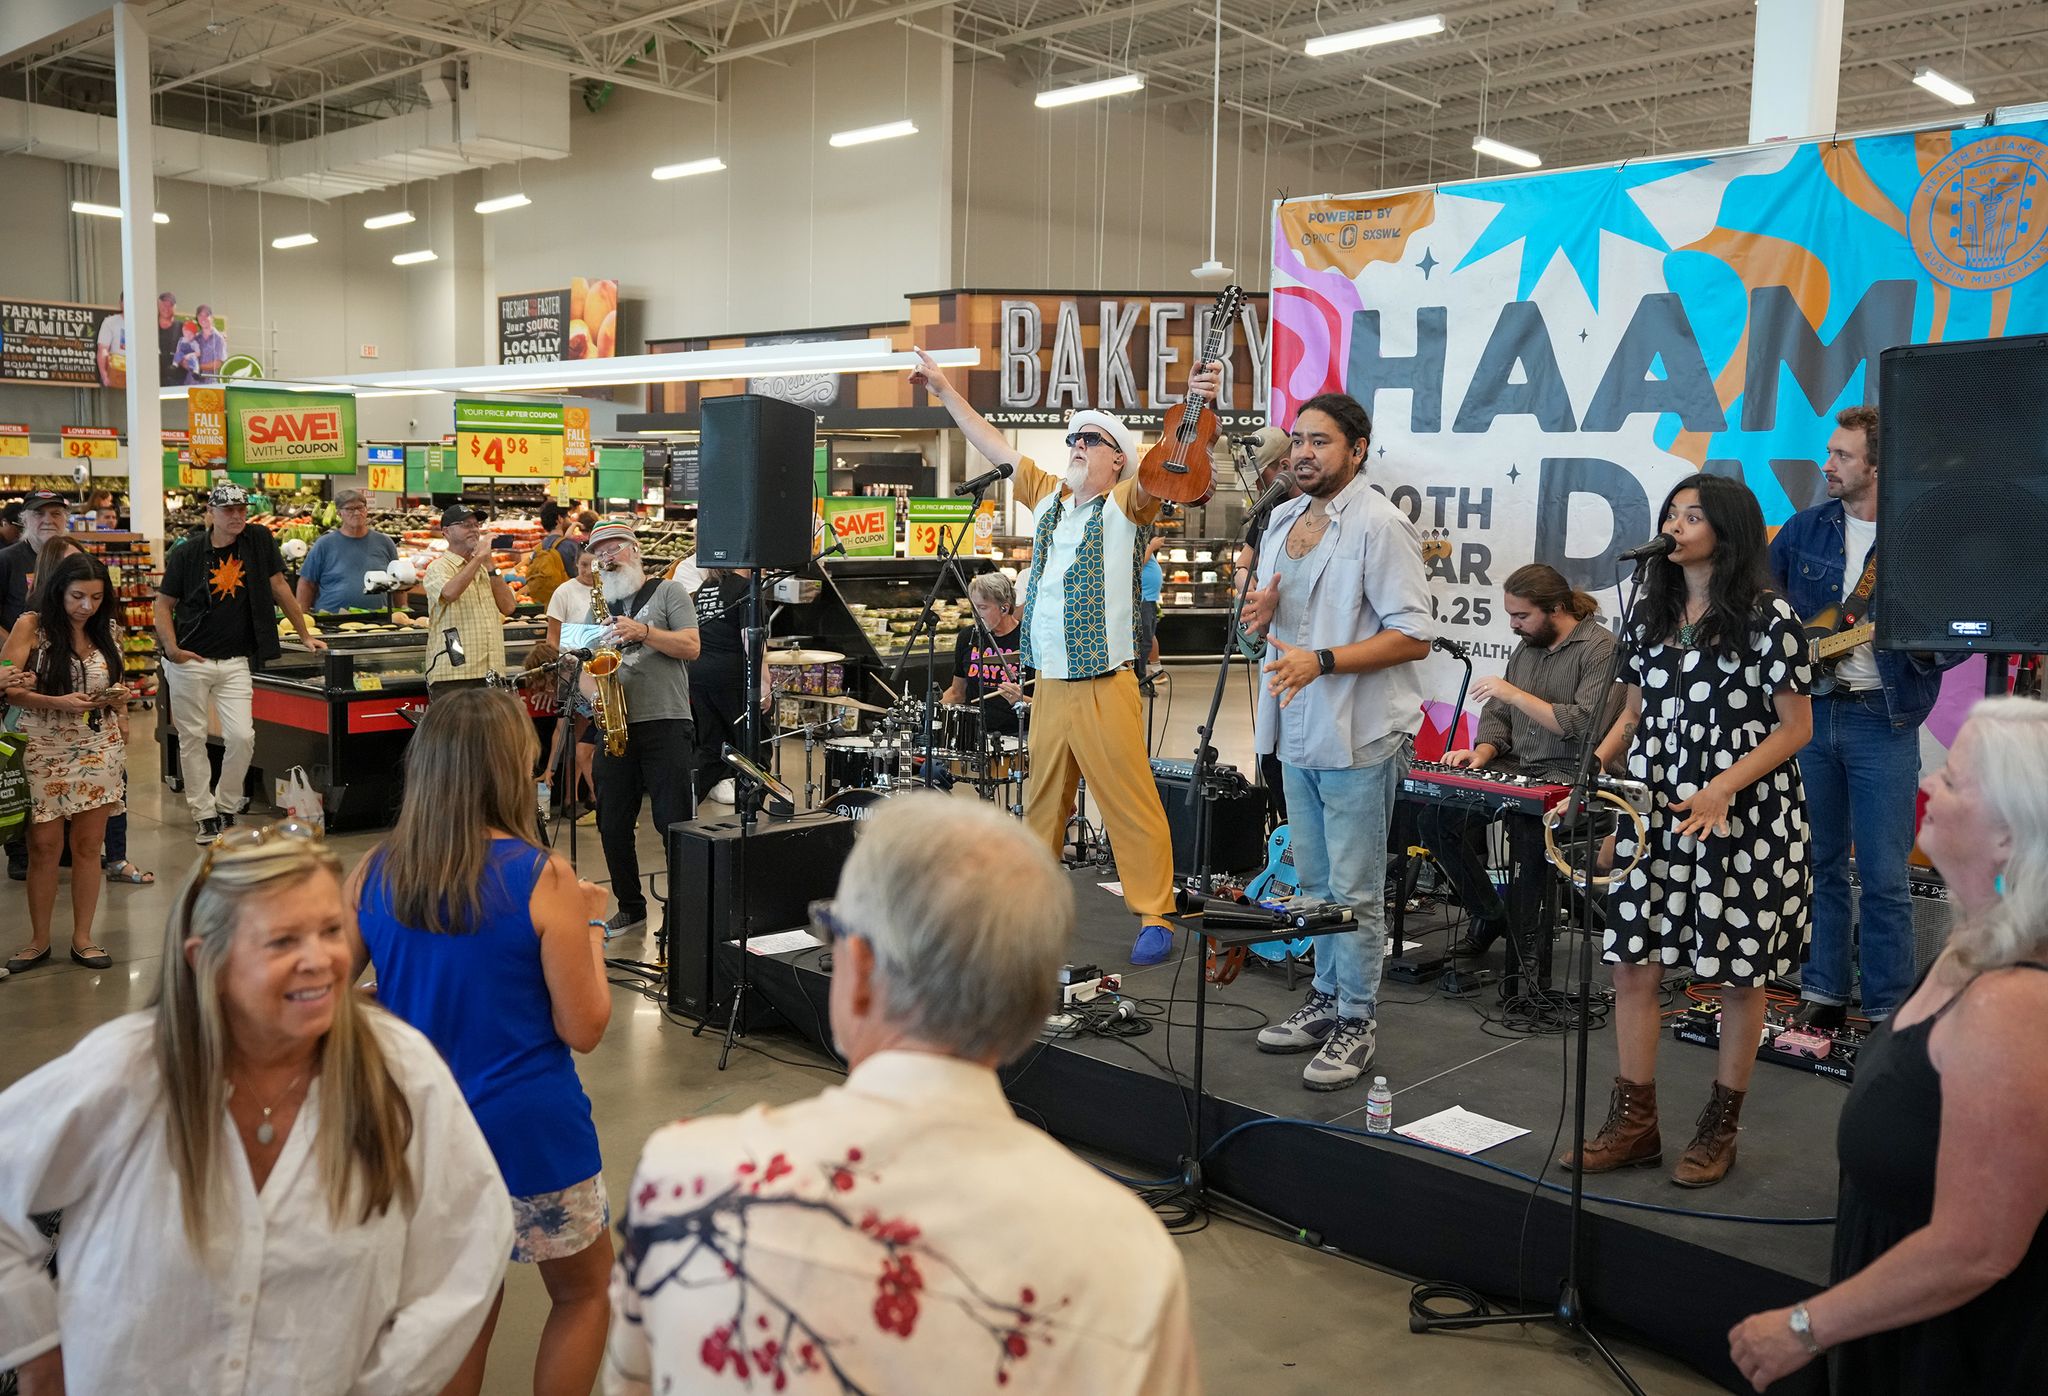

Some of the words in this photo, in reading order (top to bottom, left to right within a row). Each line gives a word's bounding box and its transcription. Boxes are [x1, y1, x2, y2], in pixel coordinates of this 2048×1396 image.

[1923, 150, 1970, 194] HEALTH
[1974, 140, 2047, 160] ALLIANCE
[1308, 209, 1373, 224] POWERED
[1376, 207, 1393, 219] BY
[1312, 232, 1336, 245] PNC
[1362, 228, 1393, 241] SXSW
[1923, 249, 1966, 283] AUSTIN
[2, 304, 94, 324] FARM-FRESH
[502, 299, 530, 320] FRESHER
[537, 295, 561, 316] FASTER
[13, 318, 85, 337] FAMILY
[526, 317, 560, 333] SOURCE
[503, 337, 561, 356] LOCALLY
[1001, 300, 1269, 411] BAKERY
[1345, 279, 1918, 434] HAAM
[194, 412, 221, 428] FALL
[463, 408, 484, 416] YOUR
[484, 409, 505, 417] PRICE
[505, 410, 529, 418] AFTER
[529, 411, 559, 419] COUPON
[983, 412, 1061, 423] ALWAYS
[67, 427, 85, 435] LOW
[196, 428, 219, 436] INTO
[248, 412, 339, 444] SAVE!
[567, 428, 586, 441] FALL
[191, 435, 224, 445] SAVINGS
[251, 445, 283, 457] WITH
[287, 442, 338, 455] COUPON
[833, 511, 885, 537] SAVE!
[855, 534, 885, 545] COUPON
[1951, 622, 1987, 631] QSC
[1814, 1063, 1840, 1076] metro
